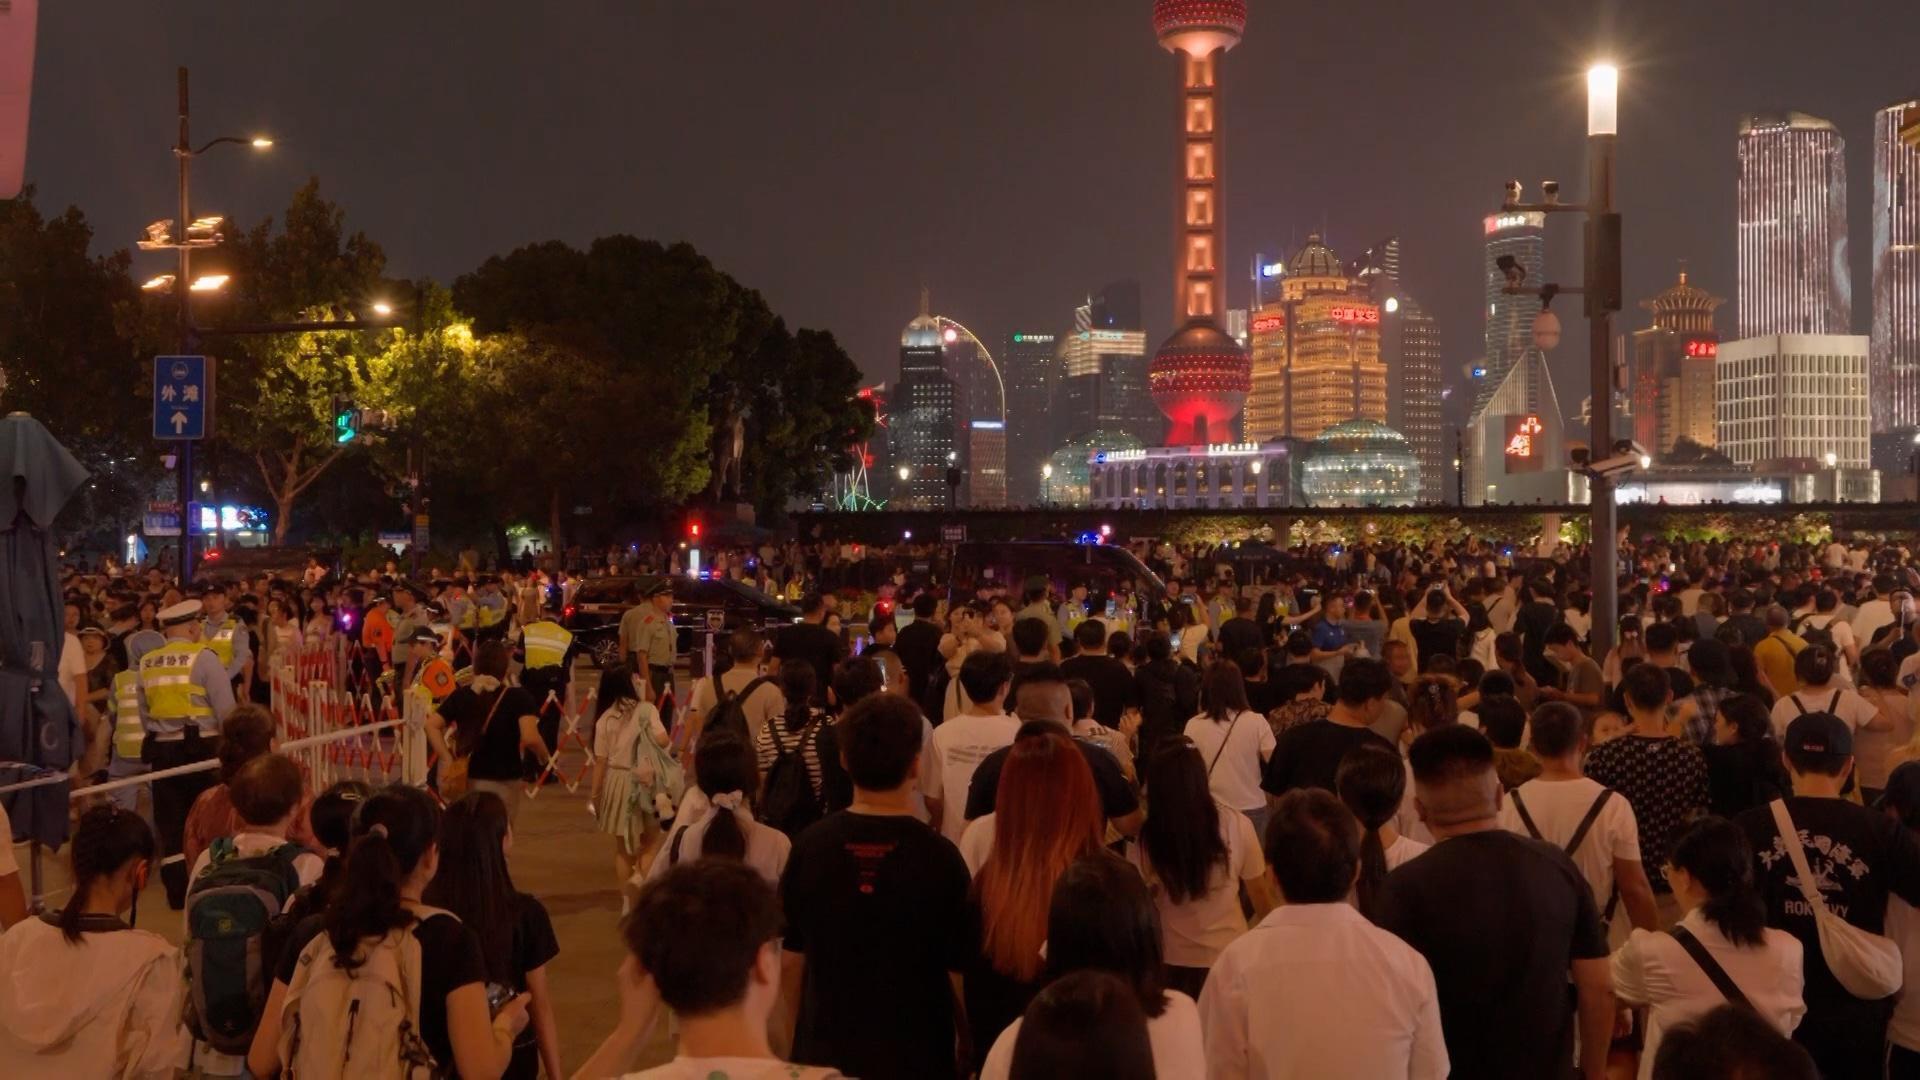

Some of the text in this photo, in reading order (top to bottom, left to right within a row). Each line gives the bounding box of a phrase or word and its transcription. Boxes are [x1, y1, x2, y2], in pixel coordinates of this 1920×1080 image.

[161, 384, 199, 402] 外滩
[144, 655, 190, 668] 交通协管
[1784, 901, 1814, 916] ROK
